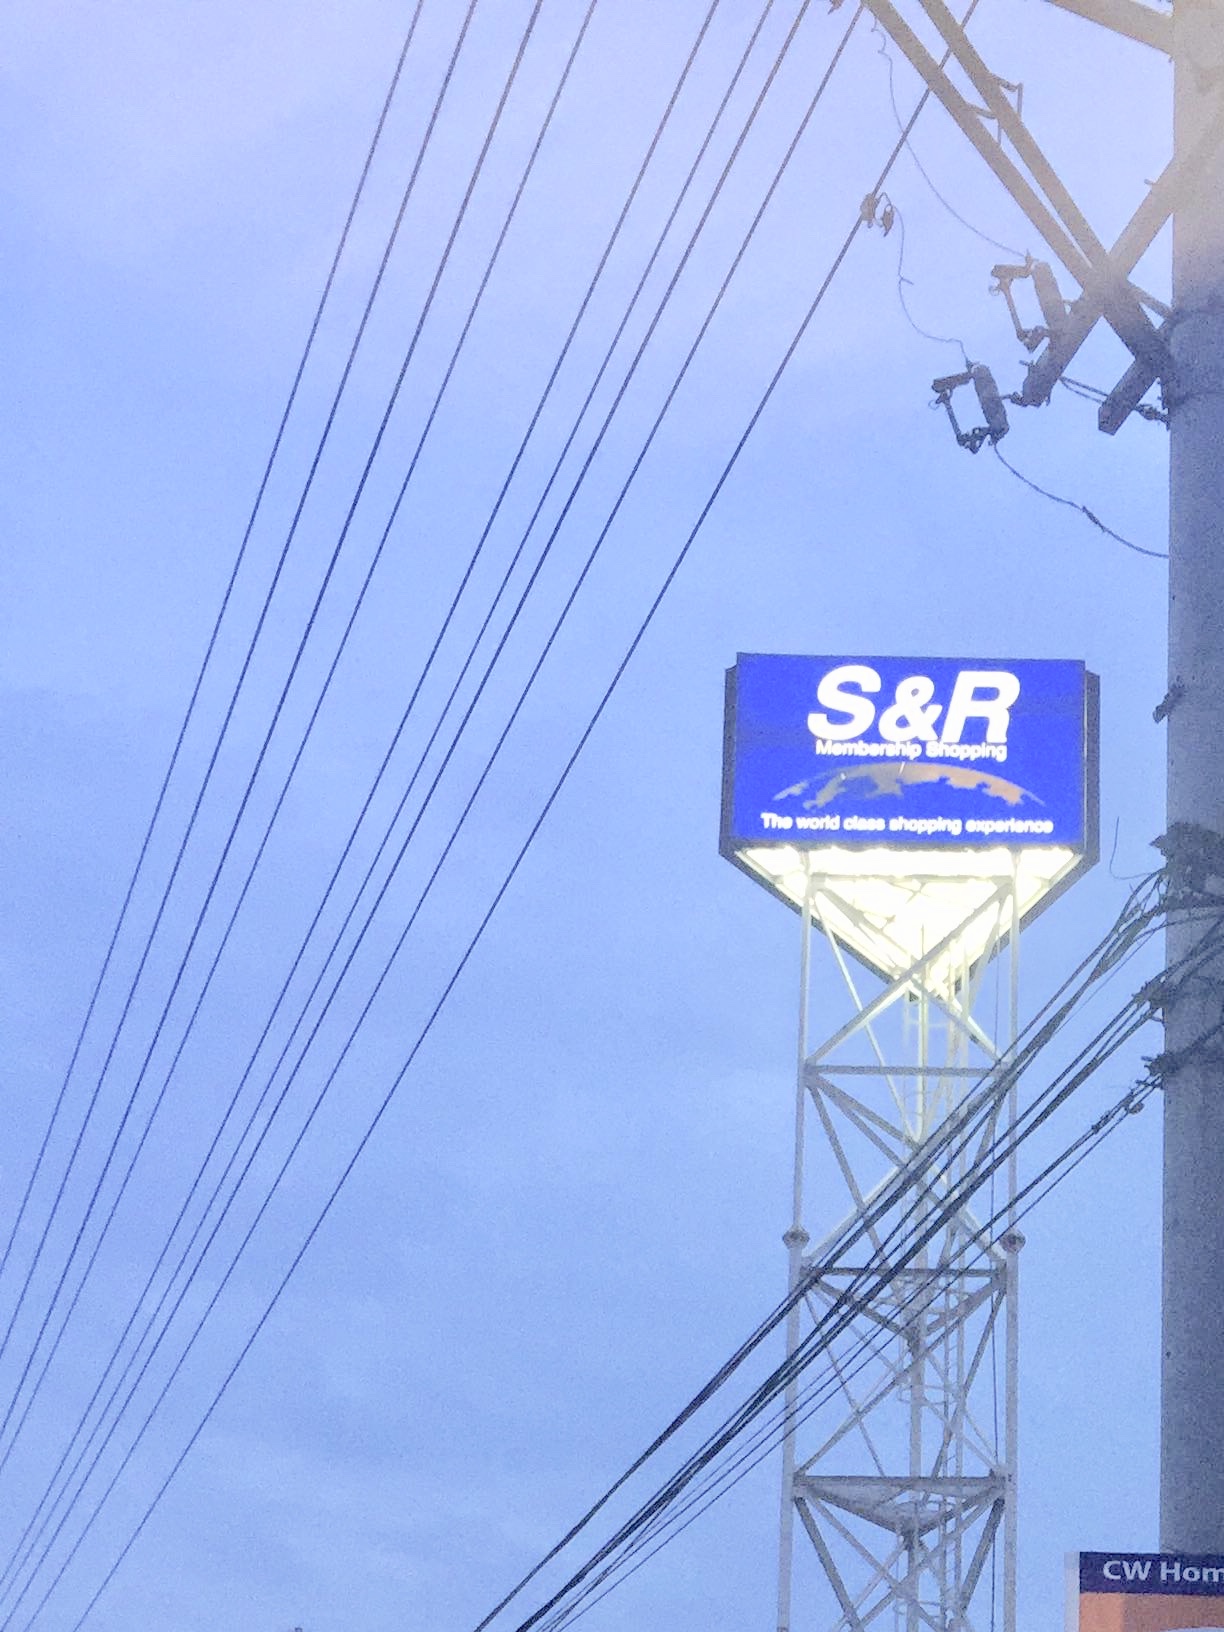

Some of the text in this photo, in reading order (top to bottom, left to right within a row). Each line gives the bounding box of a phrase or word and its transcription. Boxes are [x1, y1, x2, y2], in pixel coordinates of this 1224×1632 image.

[807, 664, 1020, 742] S&R
[815, 739, 1007, 761] Membership Shopping
[761, 812, 792, 829] The
[796, 815, 840, 830] world
[889, 816, 961, 834] shopping
[966, 816, 1053, 833] experience
[1102, 1560, 1152, 1581] CW
